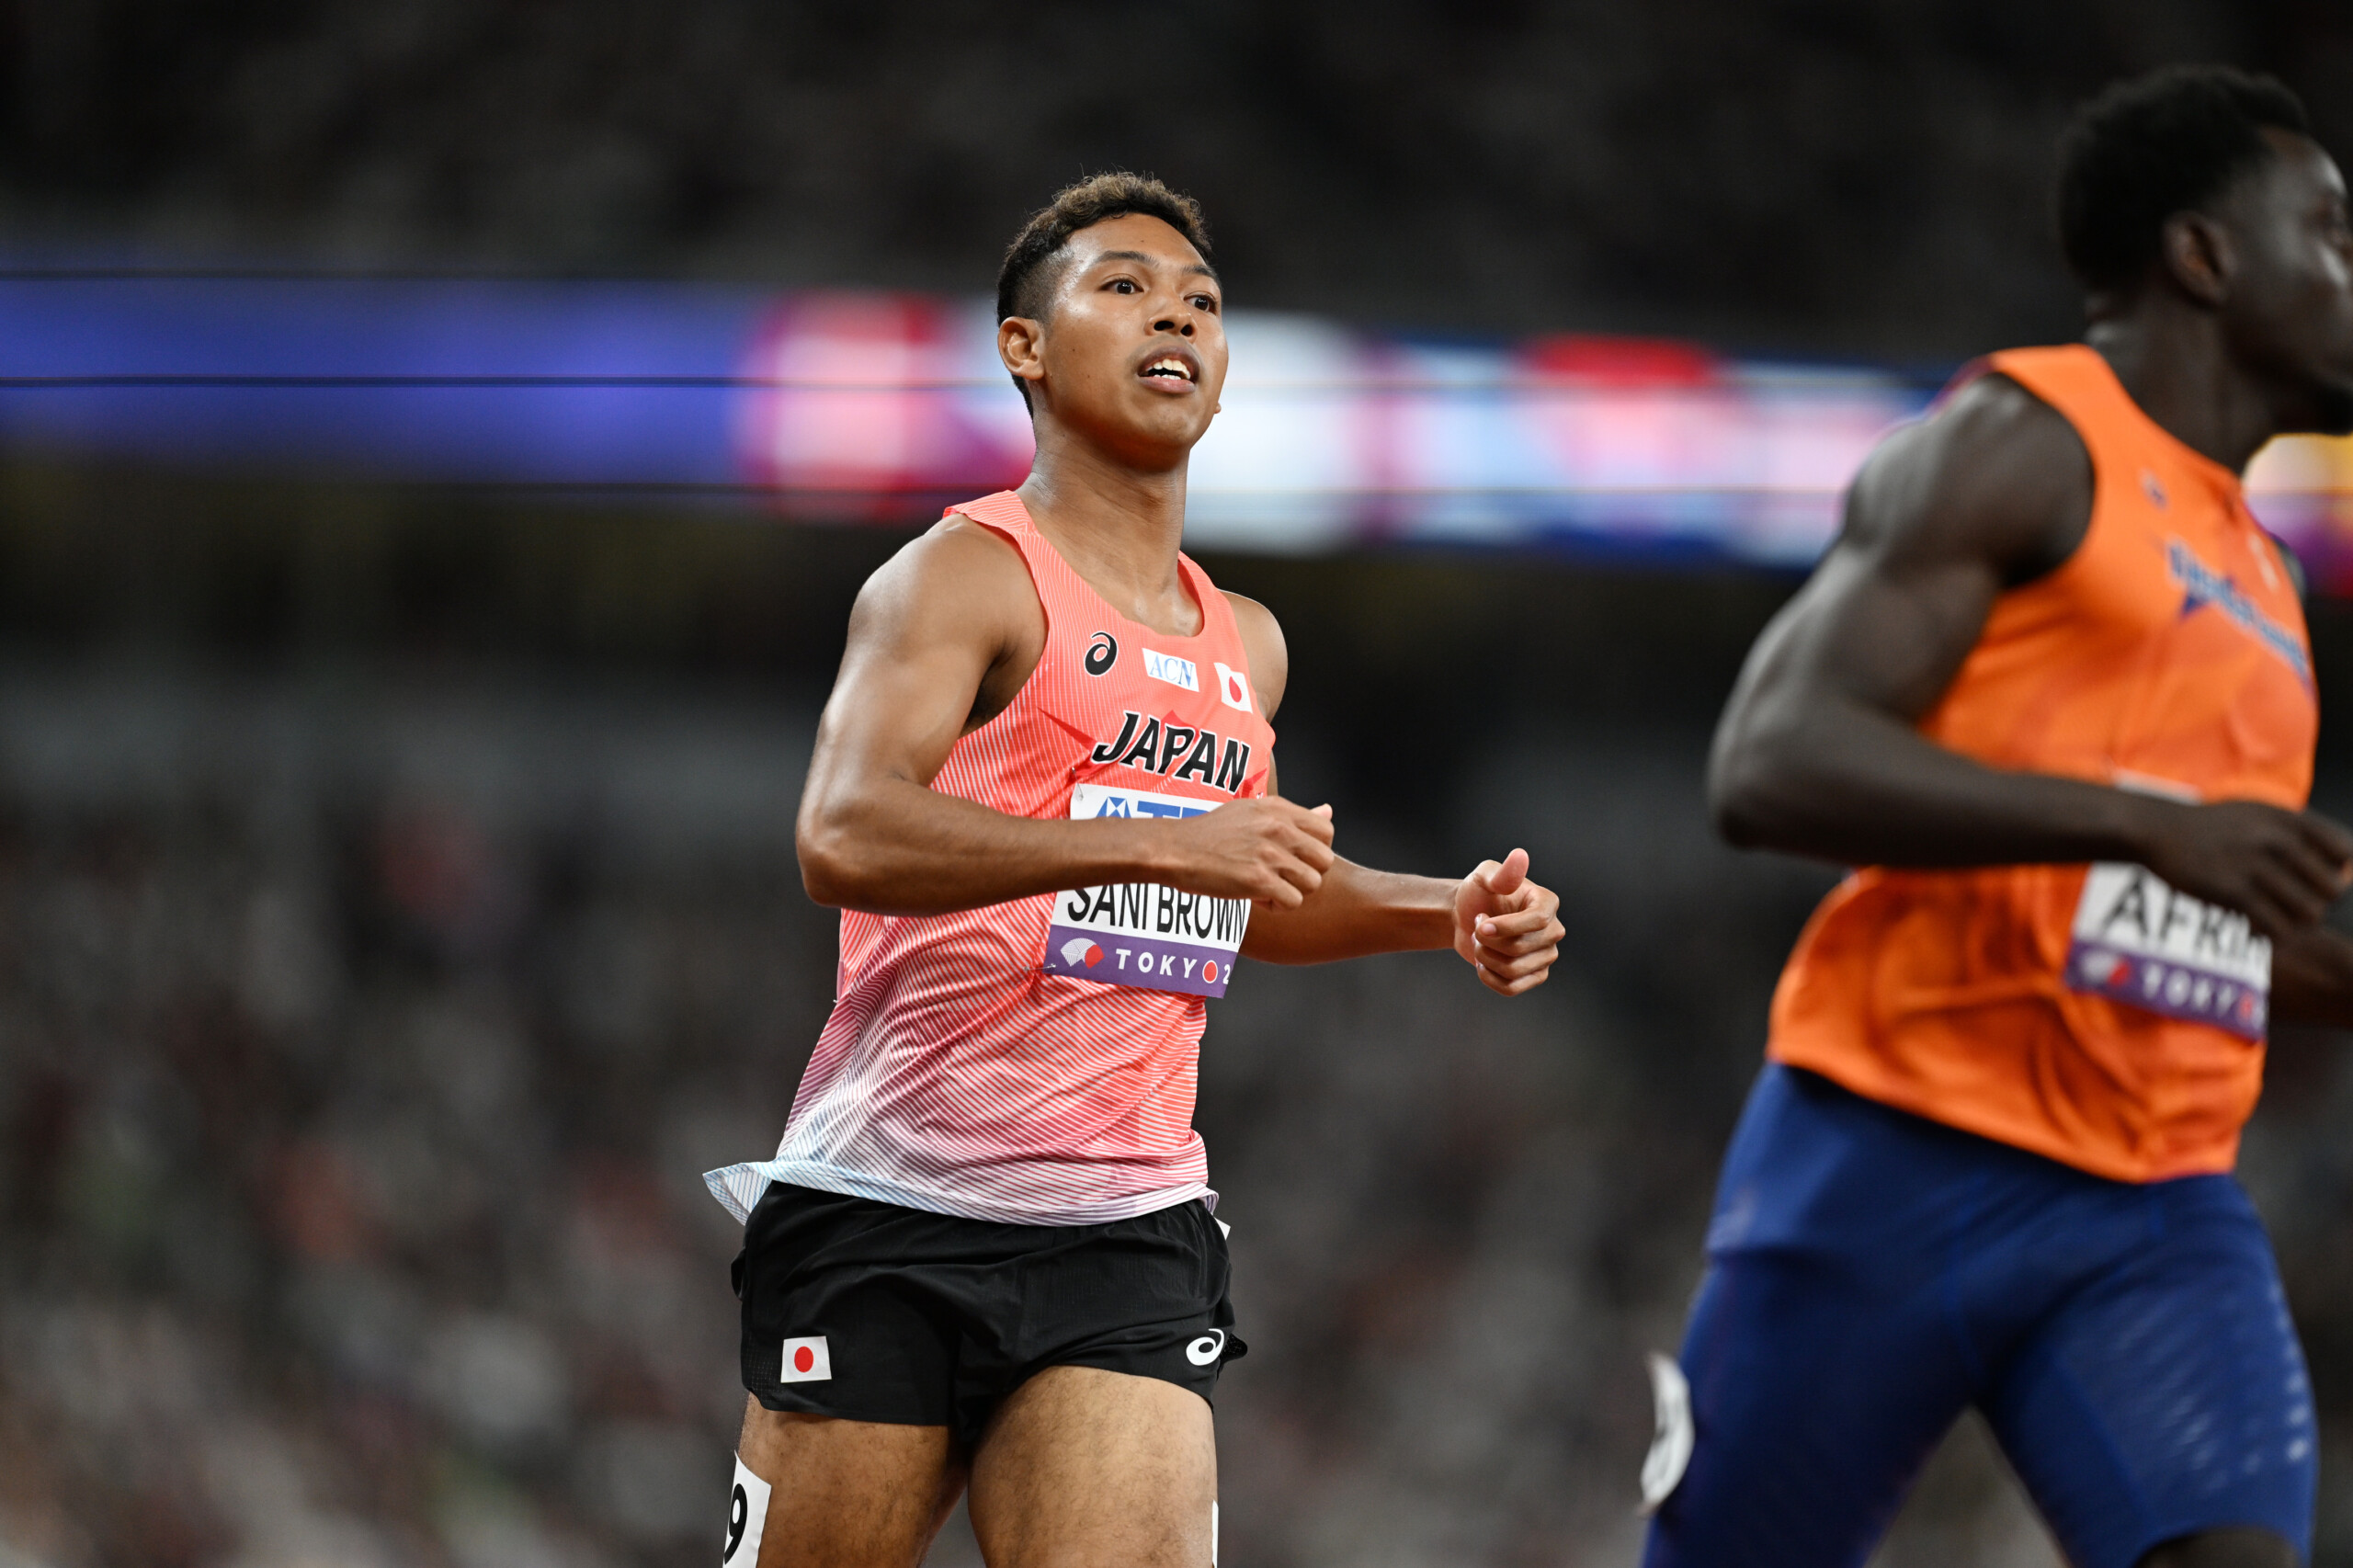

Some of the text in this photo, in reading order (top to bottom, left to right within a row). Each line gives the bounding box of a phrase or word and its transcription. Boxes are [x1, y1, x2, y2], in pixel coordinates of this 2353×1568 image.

[1149, 653, 1195, 687] ACN
[1090, 709, 1251, 795] JAPAN
[1067, 882, 1246, 946] SANI BROWN
[1115, 948, 1219, 984] TOKYO
[723, 1483, 748, 1565] 9
